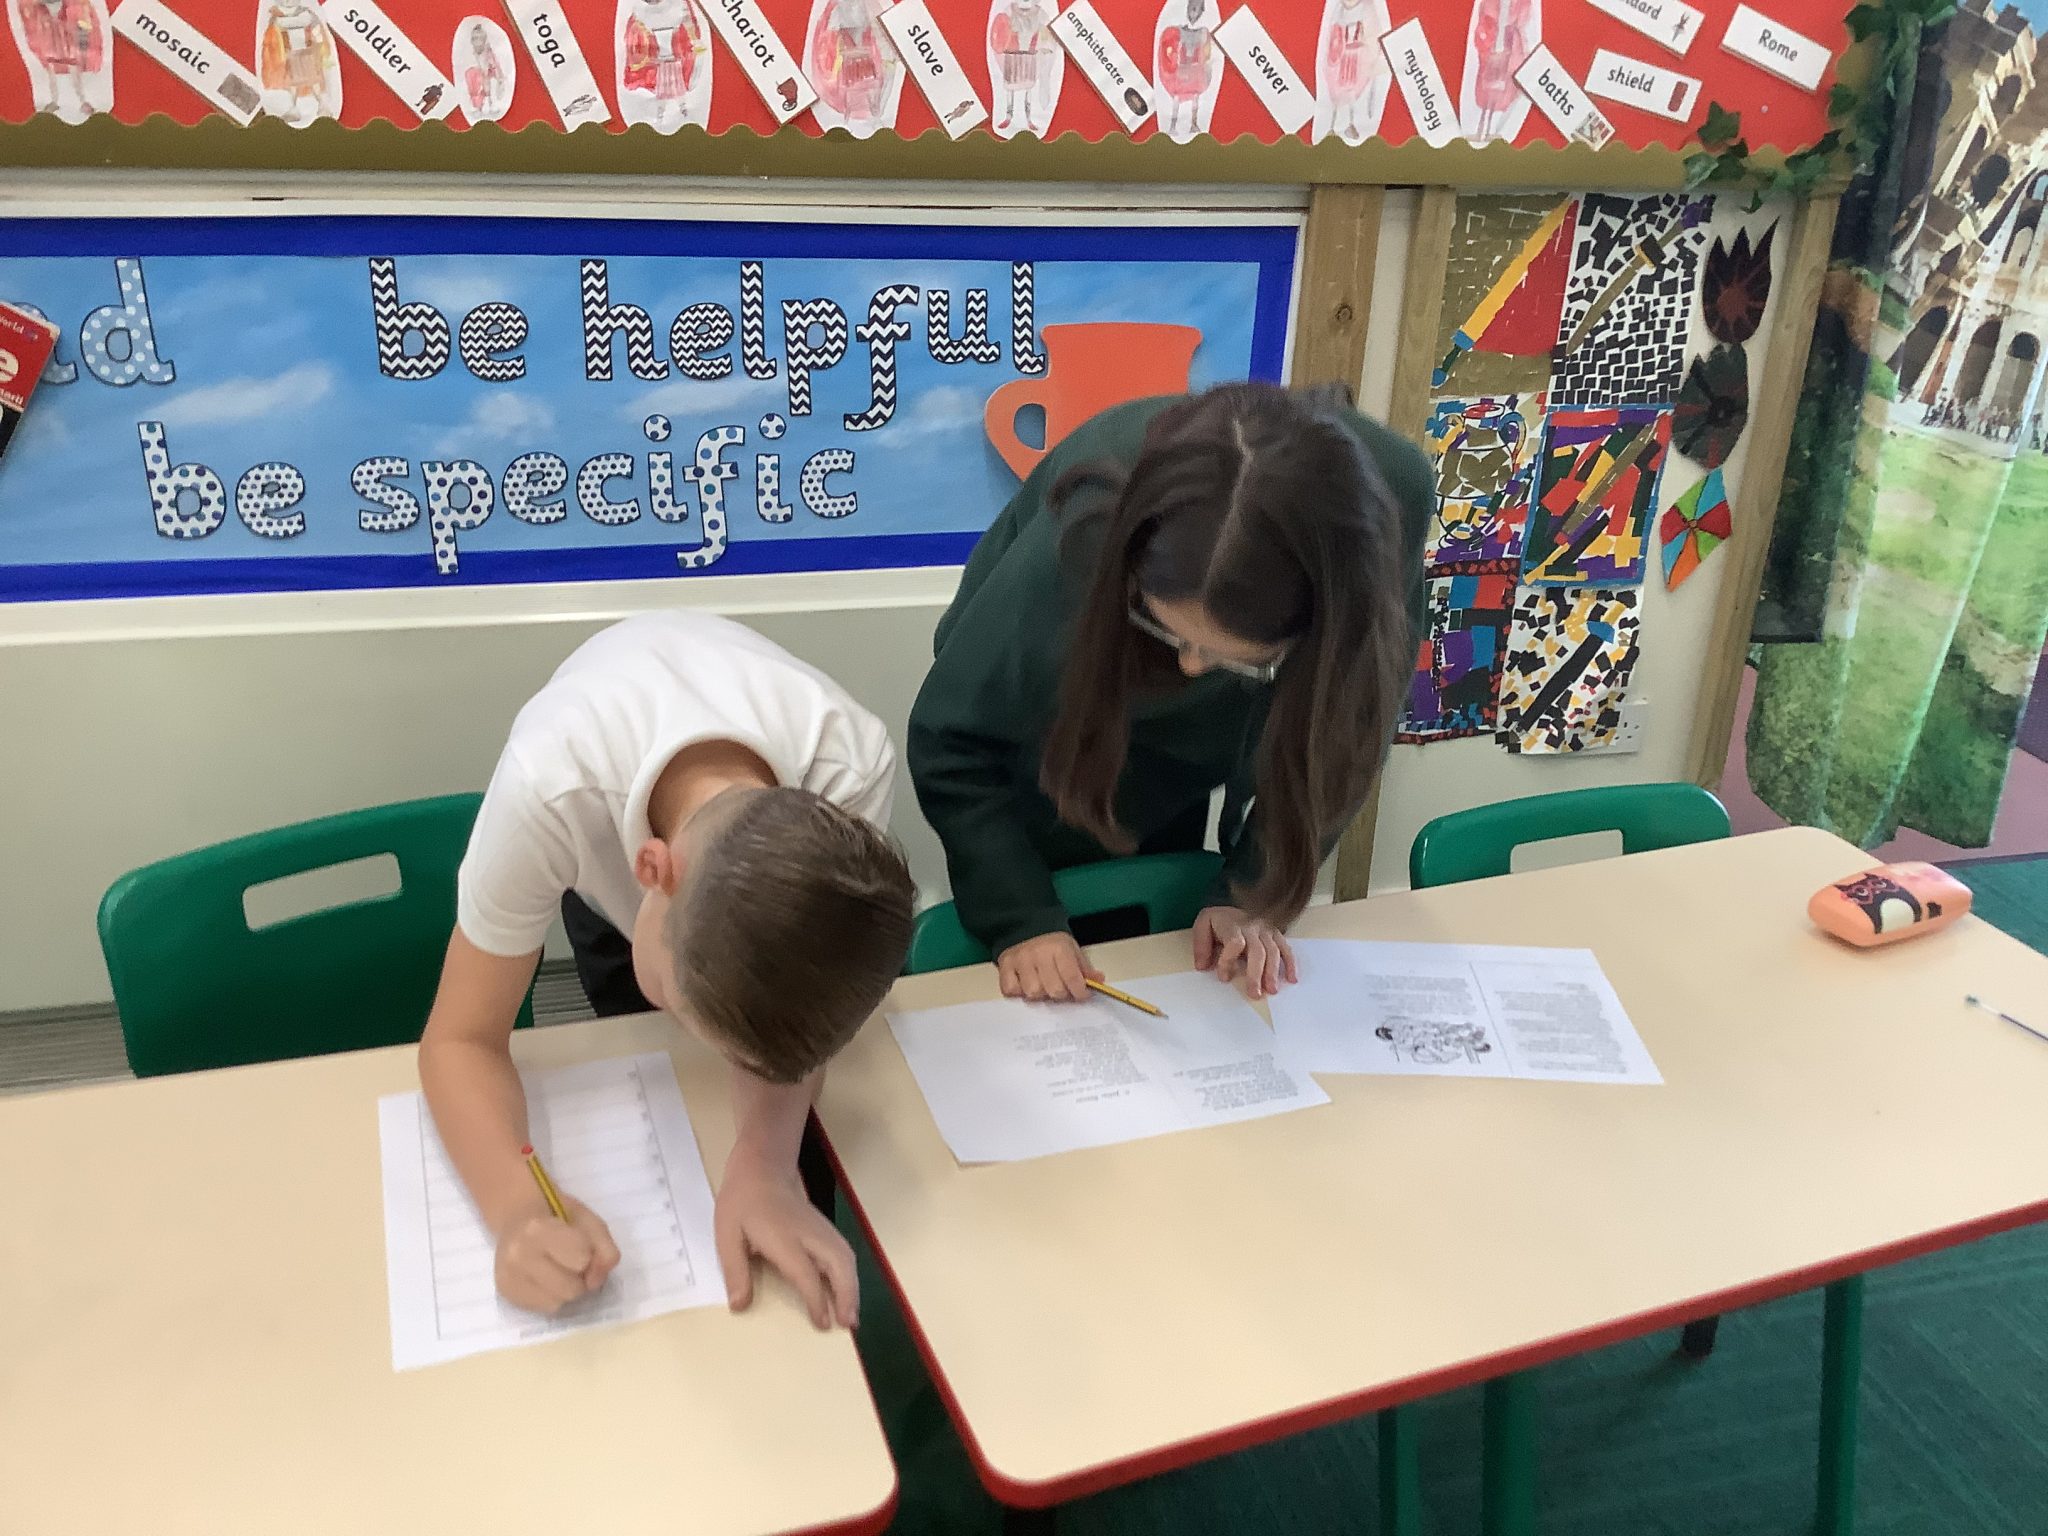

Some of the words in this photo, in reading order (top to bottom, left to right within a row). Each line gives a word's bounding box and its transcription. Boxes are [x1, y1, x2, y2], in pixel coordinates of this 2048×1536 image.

[136, 13, 210, 75] mosaic
[344, 8, 411, 75] soldier
[533, 13, 566, 68] toga
[908, 24, 944, 77] slave
[1067, 11, 1125, 86] amphitheatre
[1757, 28, 1798, 62] Rome
[1248, 45, 1290, 95] sewer
[1404, 48, 1442, 131] mythology
[1537, 68, 1575, 117] baths
[1607, 66, 1656, 94] shield
[368, 257, 530, 382] be
[581, 259, 1048, 431] helpful
[136, 420, 306, 539] be
[350, 412, 858, 575] specific
